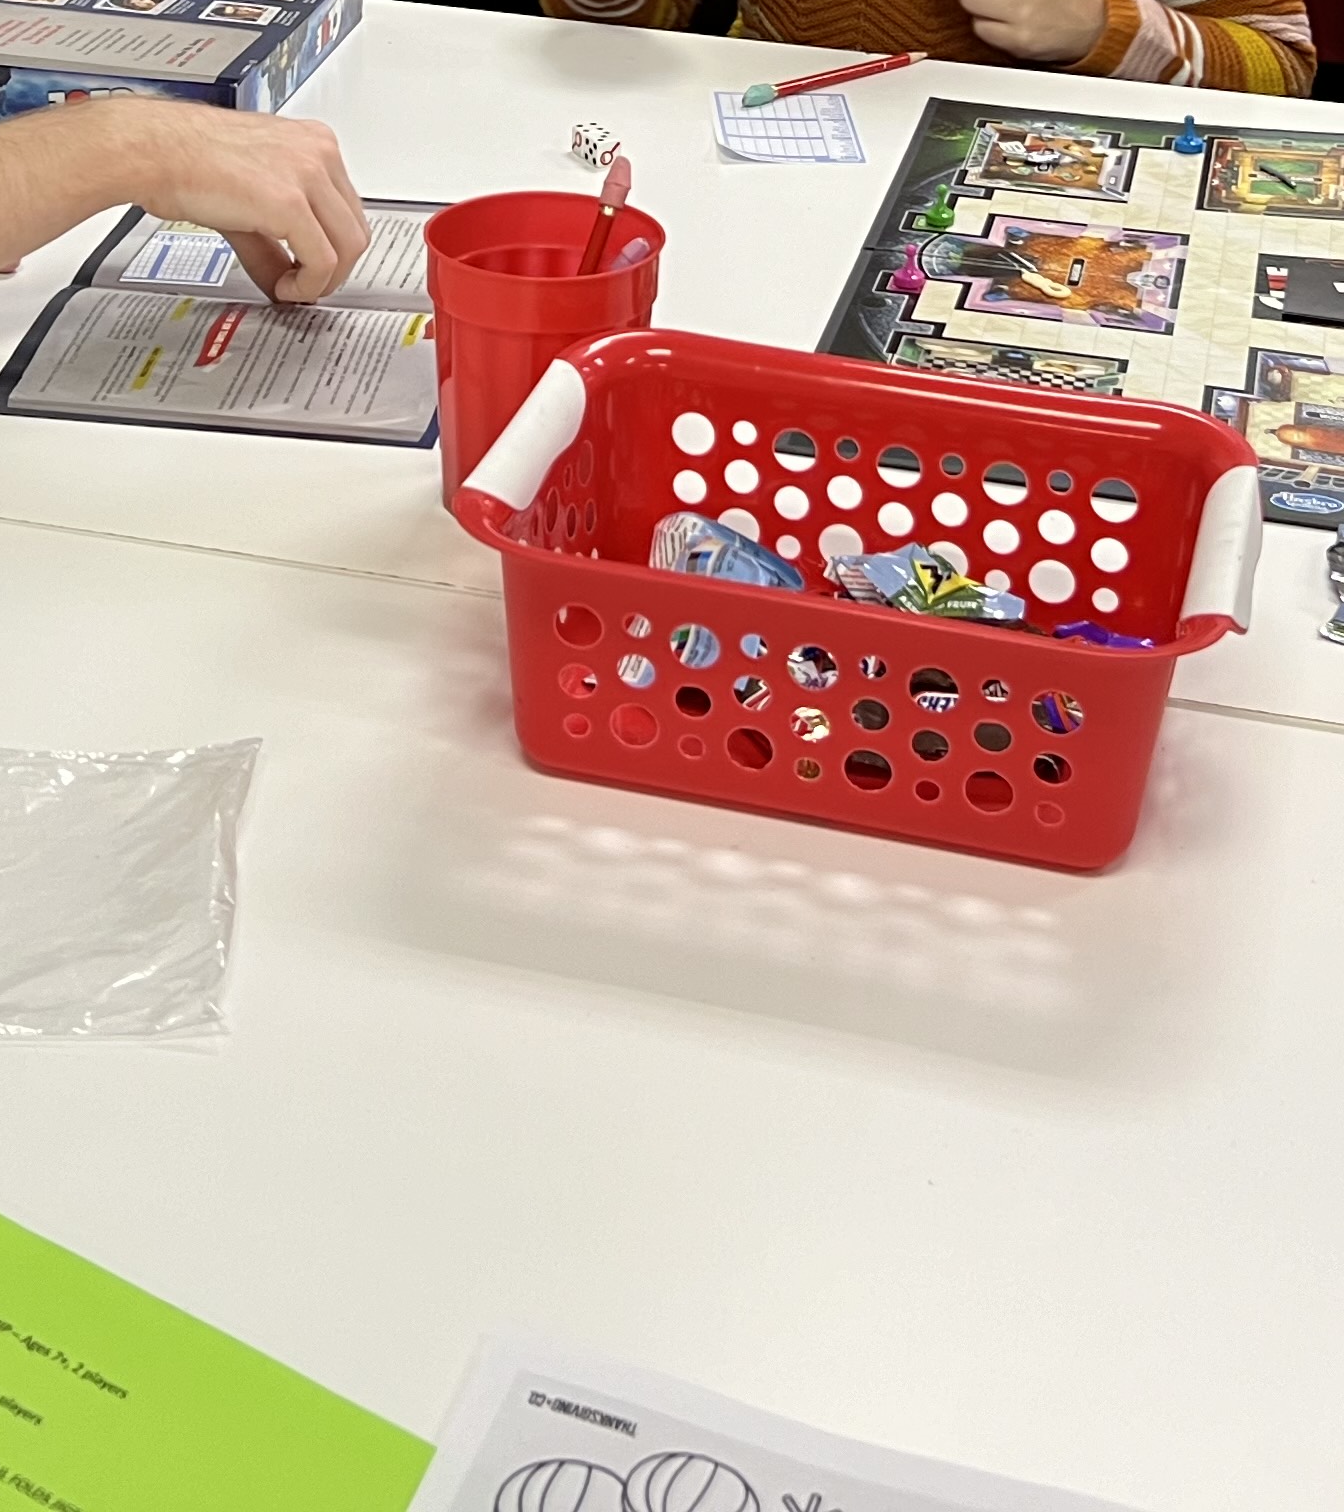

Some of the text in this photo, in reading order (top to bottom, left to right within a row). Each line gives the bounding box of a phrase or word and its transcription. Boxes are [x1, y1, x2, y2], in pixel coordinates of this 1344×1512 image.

[21, 1335, 52, 1359] Ages
[71, 1361, 85, 1376] 2
[81, 1369, 129, 1400] players
